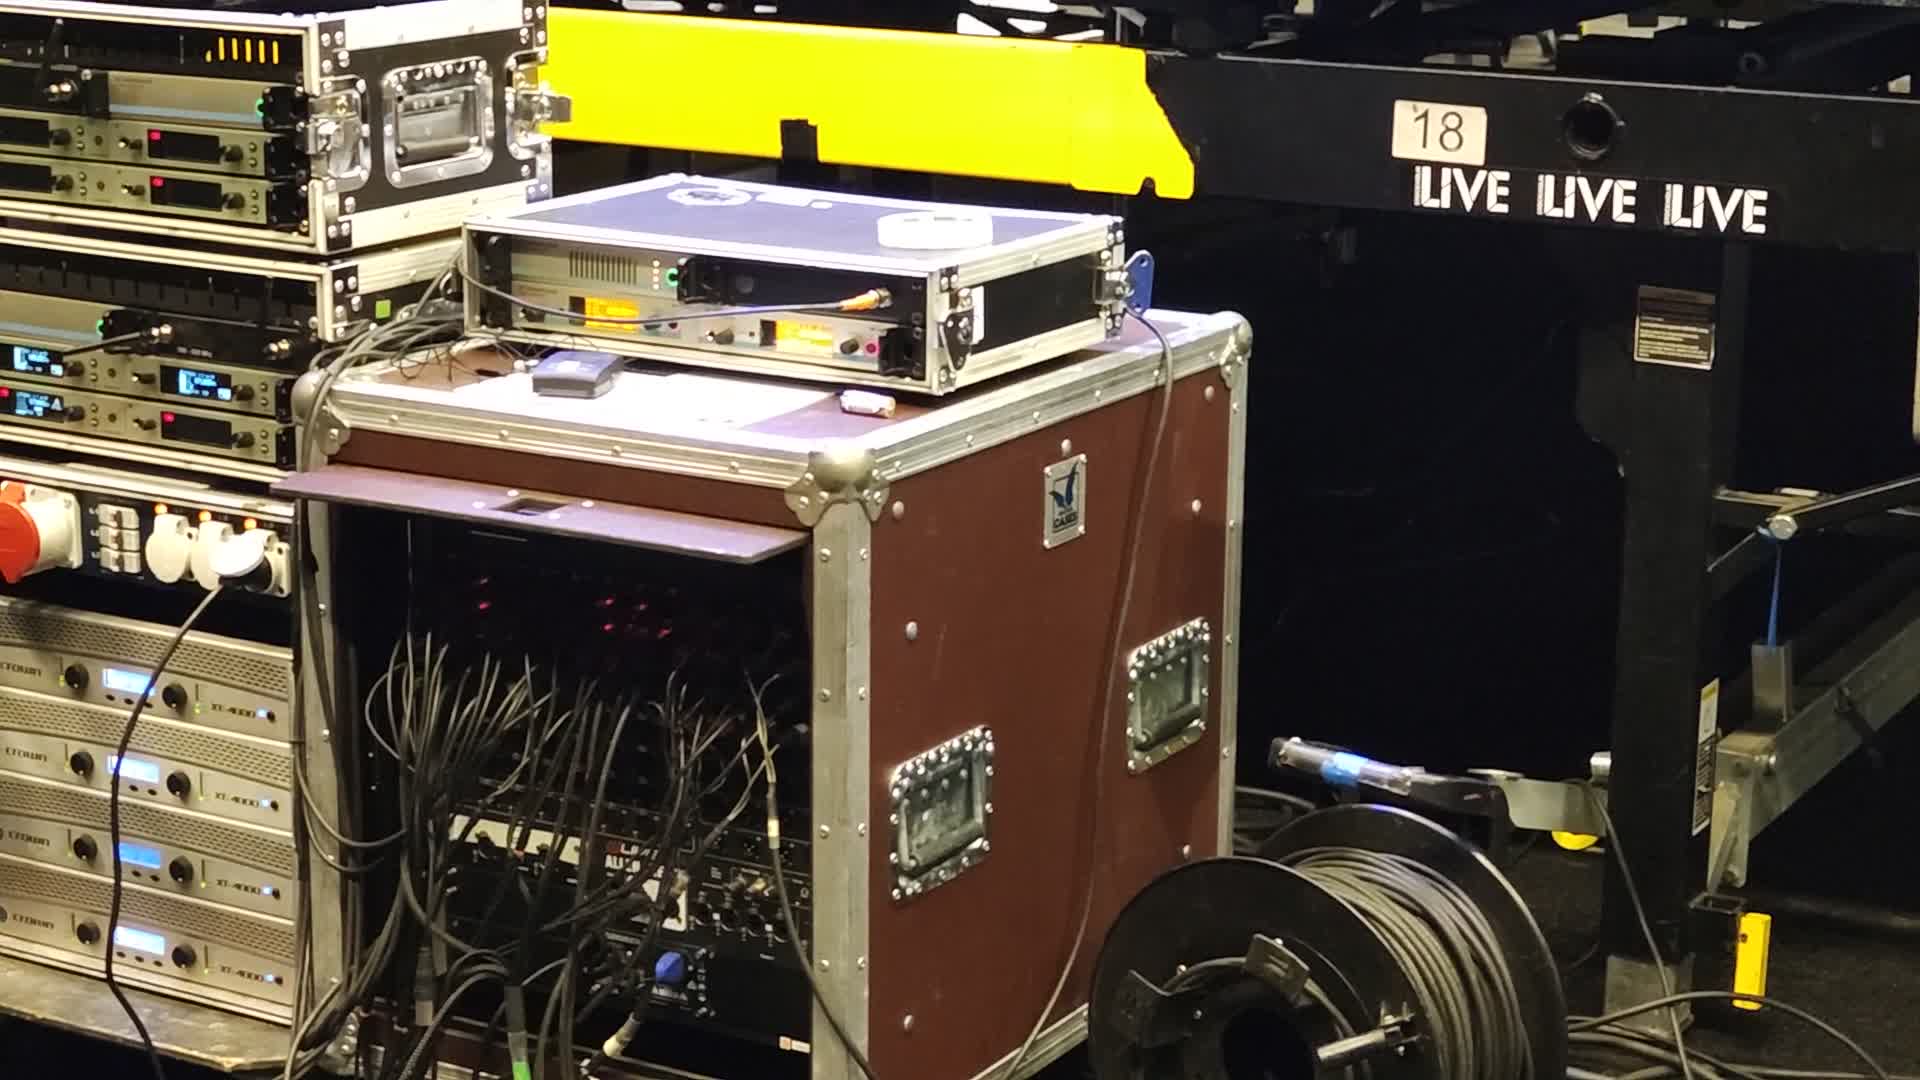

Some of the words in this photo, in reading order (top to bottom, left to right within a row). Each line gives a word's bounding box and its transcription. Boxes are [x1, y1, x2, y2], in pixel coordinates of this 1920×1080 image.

[1414, 109, 1464, 152] 18
[1414, 165, 1511, 214] LIVE
[1537, 174, 1637, 223] LIVE
[1664, 184, 1768, 234] LIVE
